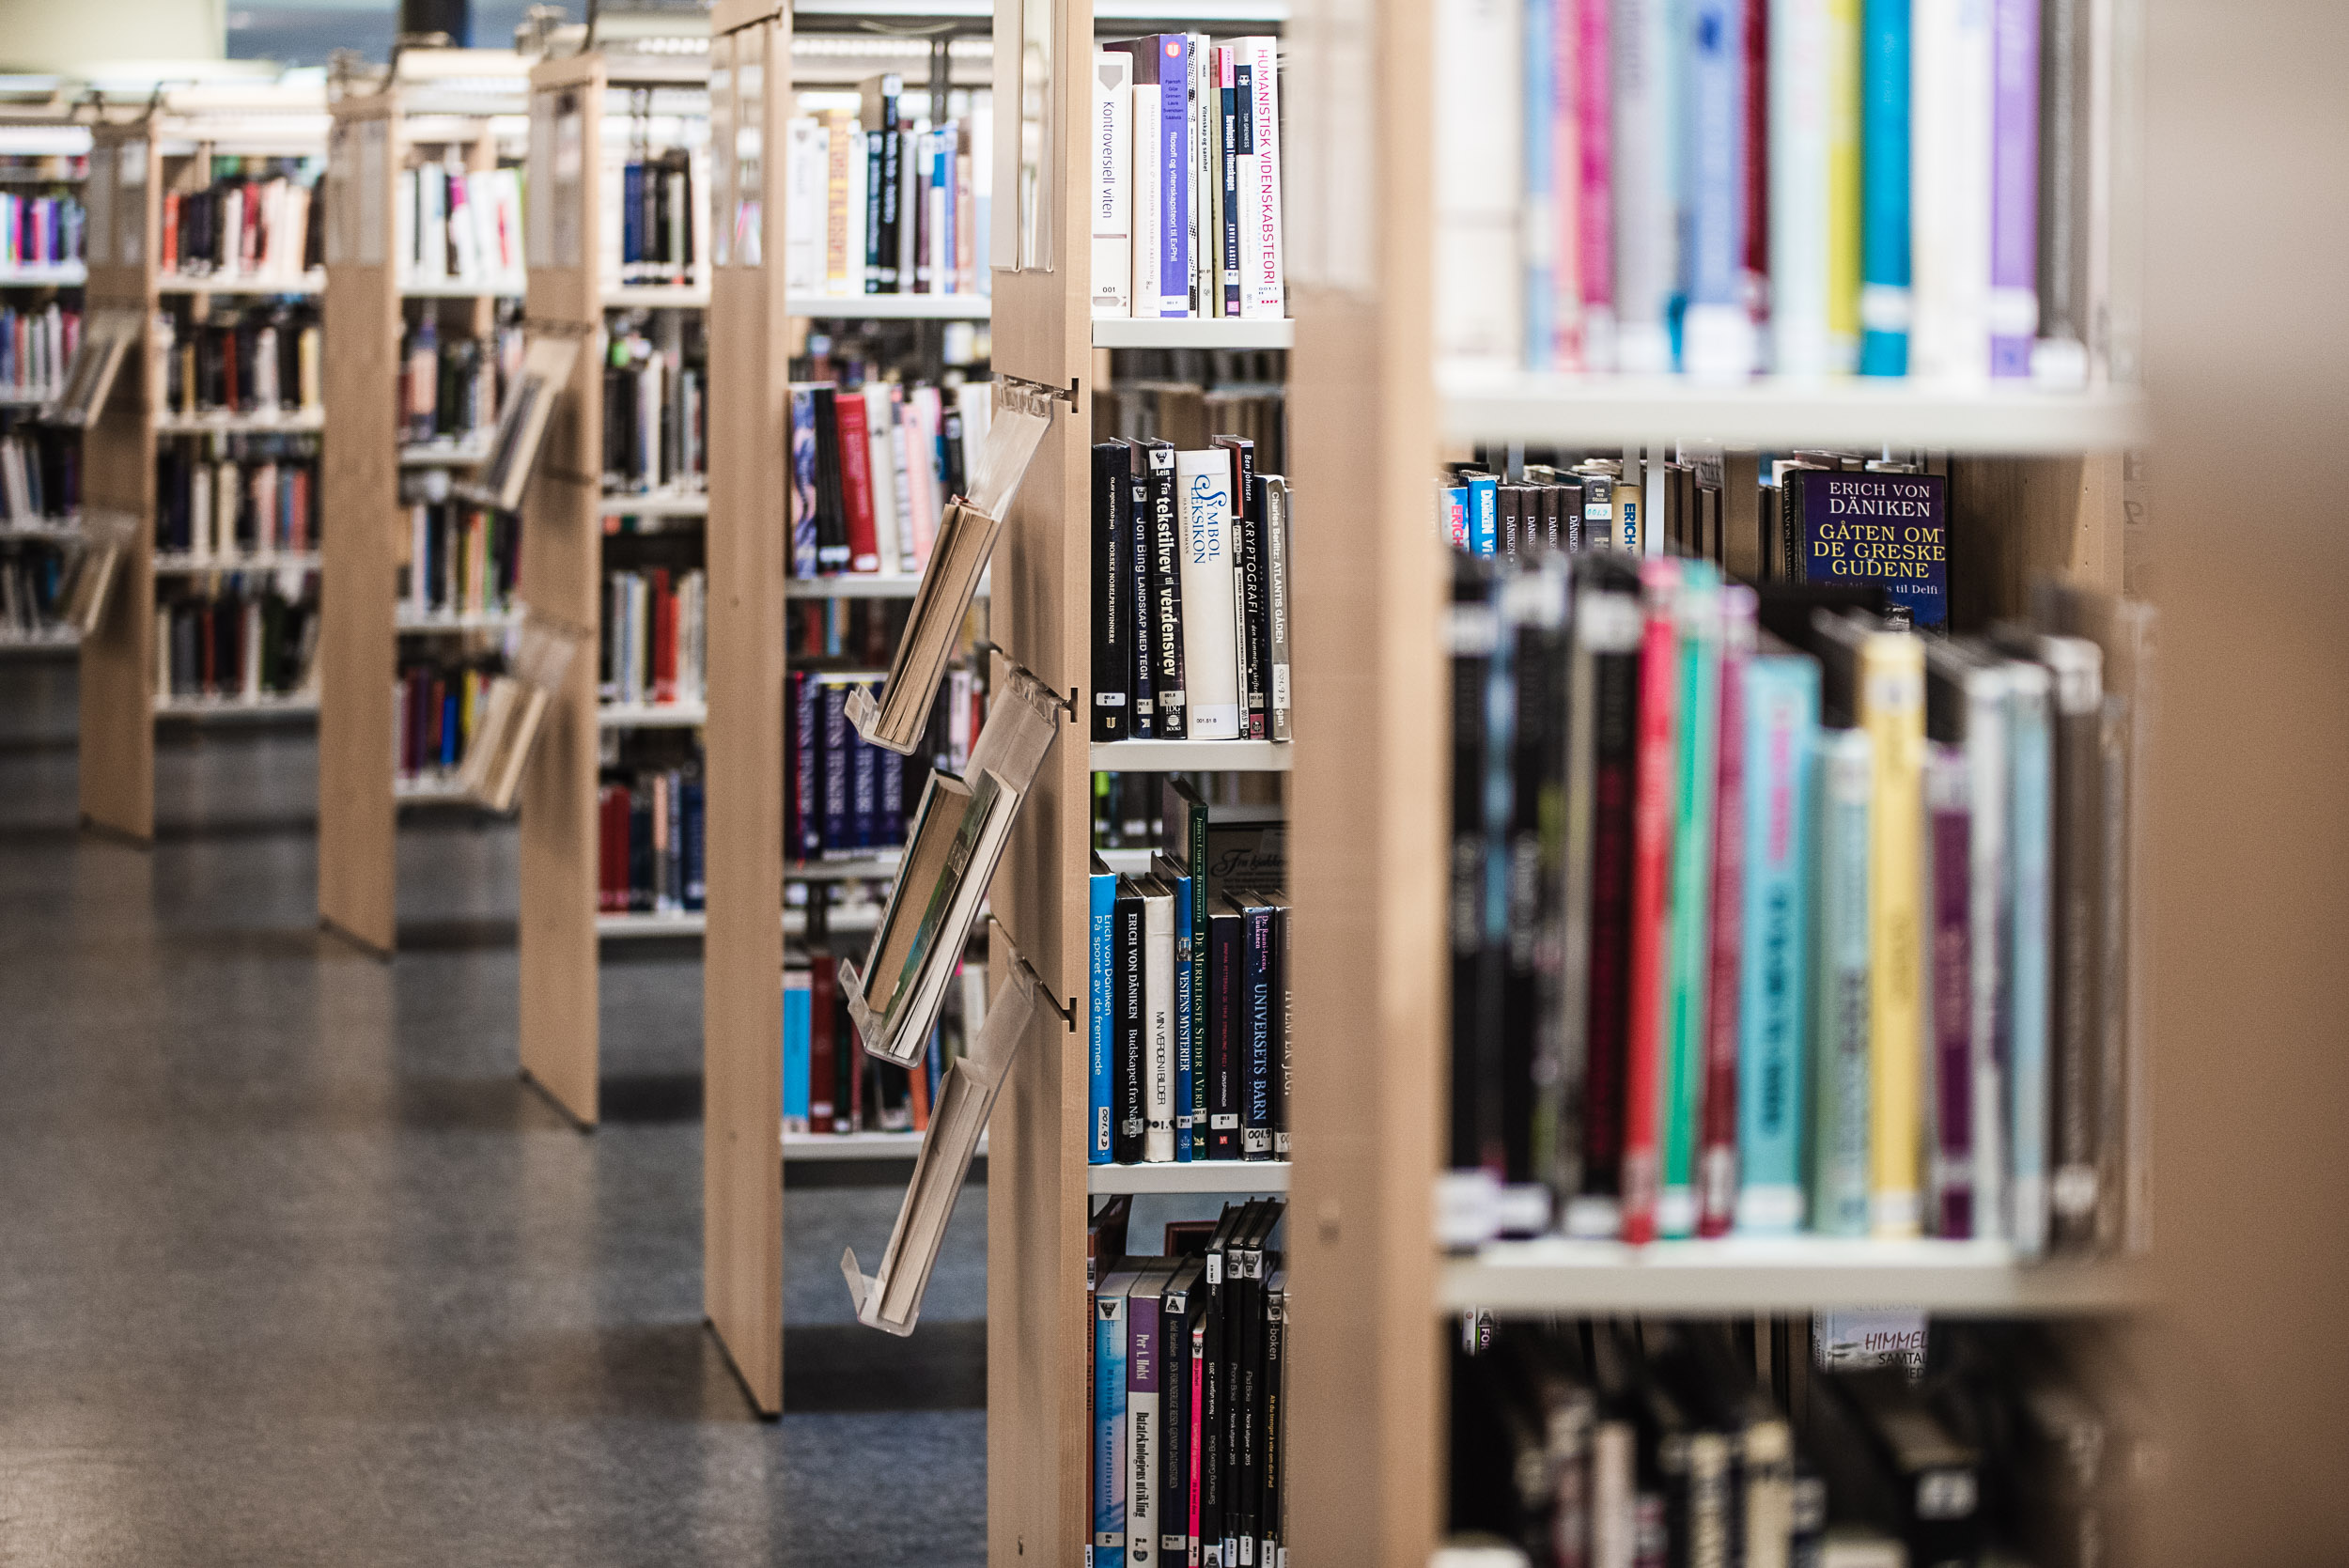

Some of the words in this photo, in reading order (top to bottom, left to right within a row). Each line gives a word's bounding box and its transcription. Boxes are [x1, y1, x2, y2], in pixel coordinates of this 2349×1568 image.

[1257, 49, 1271, 147] HUMANISTISK
[1103, 101, 1115, 183] Kontroversiell
[1225, 115, 1235, 147] Revolusjon
[1169, 159, 1175, 168] og
[1227, 154, 1237, 191] vitenskapen
[1103, 189, 1114, 218] viten
[1169, 170, 1177, 227] vitenskapsteori
[1260, 151, 1275, 284] VIDENSKABSTEORI
[1161, 483, 1170, 494] Fra
[1243, 470, 1252, 502] Johnsen
[1829, 482, 1886, 496] ERICH
[1892, 485, 1930, 498] VON
[1194, 475, 1227, 561] SYMBOL
[1271, 492, 1280, 526] Charles
[1829, 496, 1931, 517] DÄNIKEN
[1136, 518, 1146, 540] Jon
[1157, 497, 1174, 573] tekstilvev
[1191, 487, 1206, 564] LEKSIKON
[1451, 505, 1464, 547] ERICH
[1507, 516, 1517, 554] DÄNIKEN
[1625, 504, 1636, 544] ERICH
[1819, 520, 1894, 541] GÅTEN
[1905, 527, 1939, 544] OM
[1135, 545, 1146, 573] Bing
[1482, 539, 1493, 552] Vi
[1813, 541, 1845, 557] DE
[1855, 543, 1946, 561] GRESKE
[1246, 521, 1257, 613] KRYPTOGRAFI
[1832, 560, 1929, 579] GUDENE
[1273, 562, 1283, 607] ATLANTIS
[1896, 584, 1907, 594] til
[1912, 584, 1937, 595] Delfi
[1160, 588, 1178, 676] verdensvev
[1274, 609, 1284, 644] GÅDEN
[1140, 654, 1148, 679] TEGN
[1094, 916, 1103, 930] På
[1128, 913, 1138, 945] ERICH
[1093, 937, 1102, 974] sporet
[1195, 932, 1205, 948] DE
[1128, 948, 1138, 971] VON
[1094, 980, 1101, 993] av
[1128, 974, 1139, 1018] DÄNIKEN
[1179, 970, 1190, 1013] VESTENS
[1195, 952, 1205, 1023] MERKELIGSTE
[1094, 998, 1102, 1013] de
[1156, 1012, 1164, 1029] MIN
[1095, 1015, 1103, 1075] fremmede
[1180, 1015, 1190, 1071] MYSTERIER
[1253, 984, 1268, 1074] UNIVERSETS
[1127, 1030, 1138, 1086] Budskapet
[1157, 1032, 1165, 1068] VERDEN
[1195, 1028, 1205, 1067] STEDER
[1129, 1088, 1138, 1103] fra
[1253, 1080, 1267, 1120] BARN
[1129, 1106, 1138, 1138] Nazca
[1248, 1129, 1270, 1140] 001.9
[1101, 1139, 1107, 1147] D
[1136, 1334, 1149, 1348] Per
[1136, 1359, 1149, 1379] Holst
[1105, 1426, 1112, 1436] og
[1133, 1412, 1149, 1480] Datateknologiens
[1169, 1428, 1177, 1450] GJENNOM
[1268, 1453, 1273, 1463] om
[1133, 1483, 1149, 1518] utvikling
